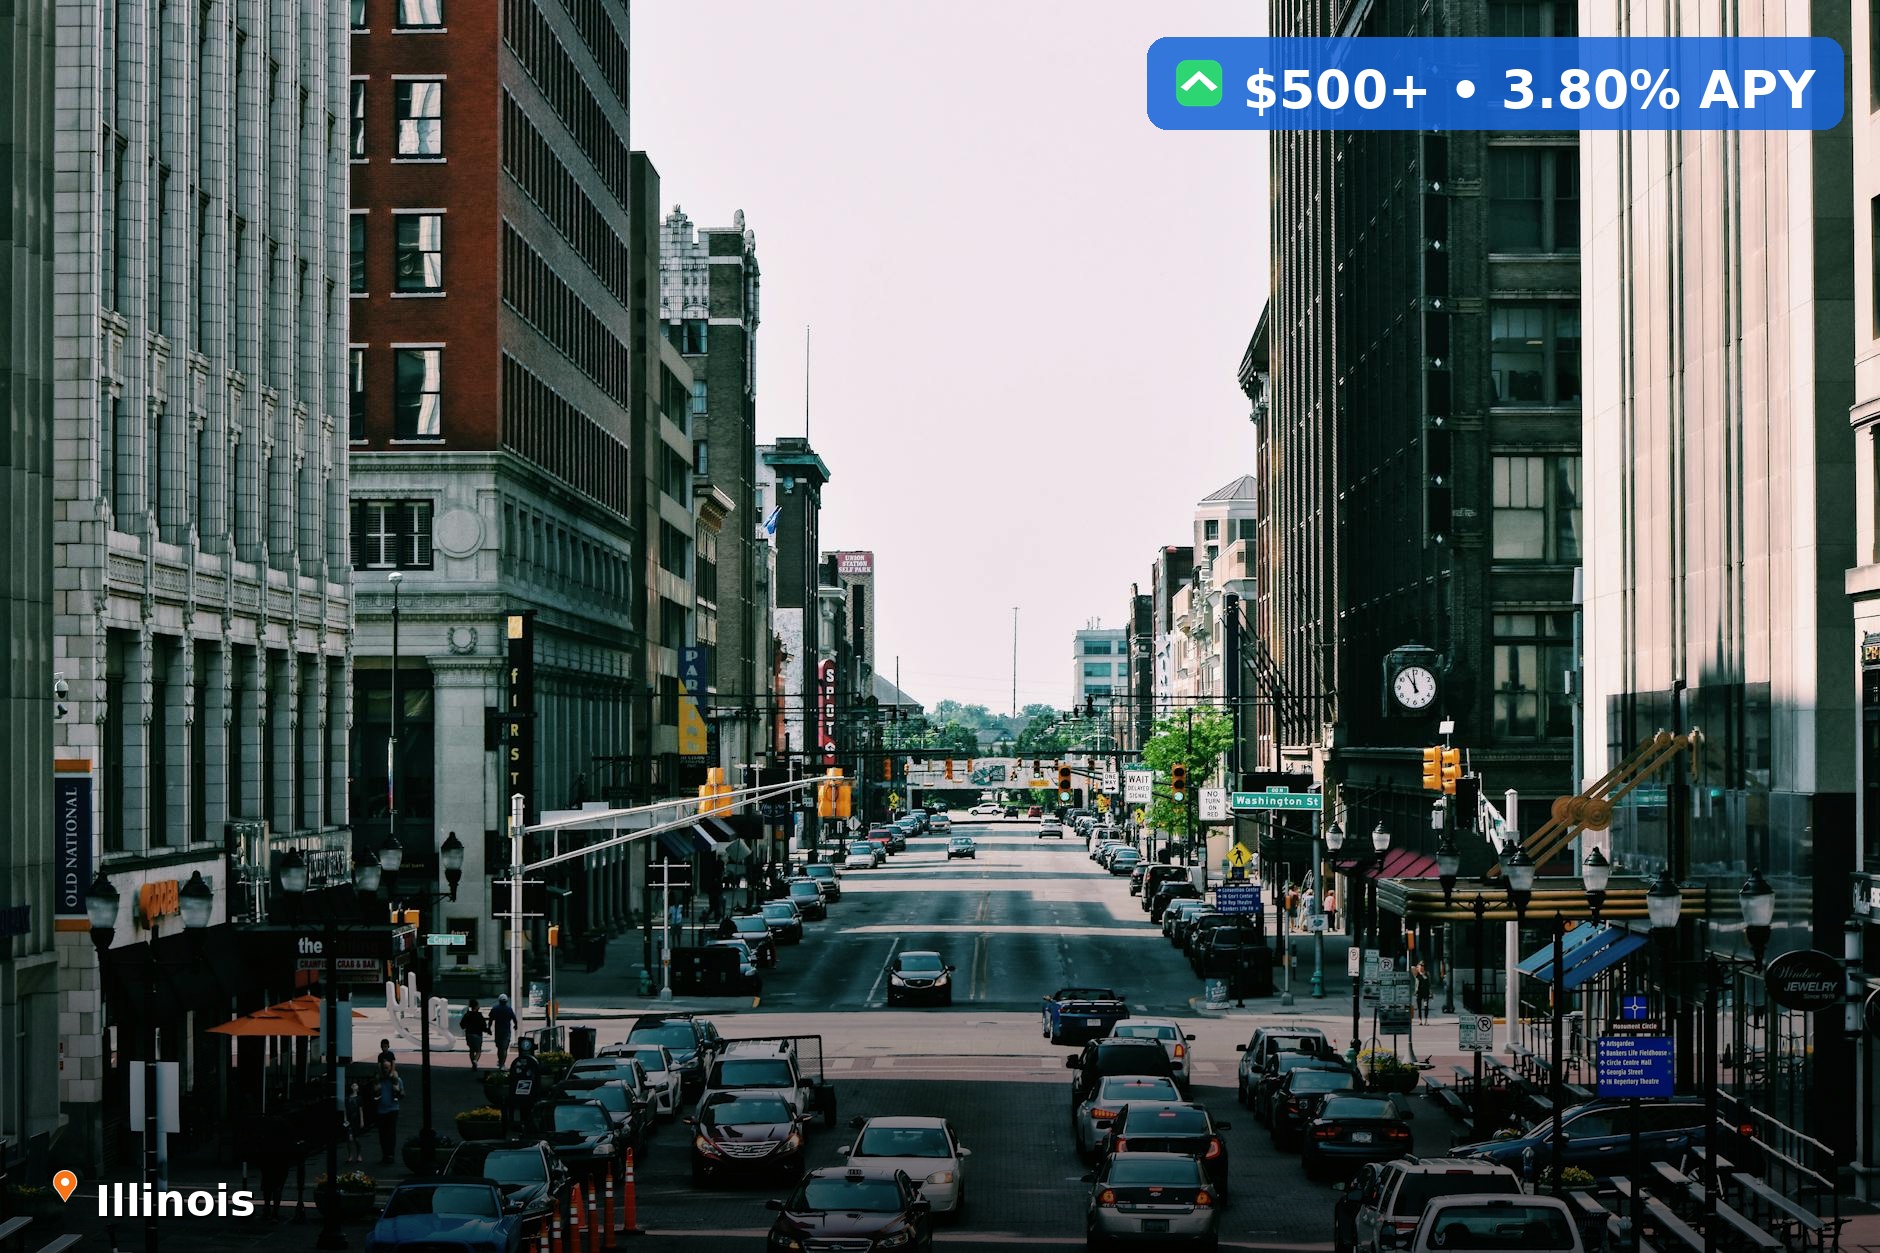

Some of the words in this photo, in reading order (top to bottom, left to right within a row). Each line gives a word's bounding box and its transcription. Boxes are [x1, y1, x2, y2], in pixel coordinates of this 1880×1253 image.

[1236, 796, 1302, 807] Washington
[1306, 798, 1318, 806] St
[65, 786, 78, 869] NATIONAL
[66, 872, 78, 908] OLD
[298, 937, 322, 954] the
[1783, 982, 1838, 992] JEWELRY
